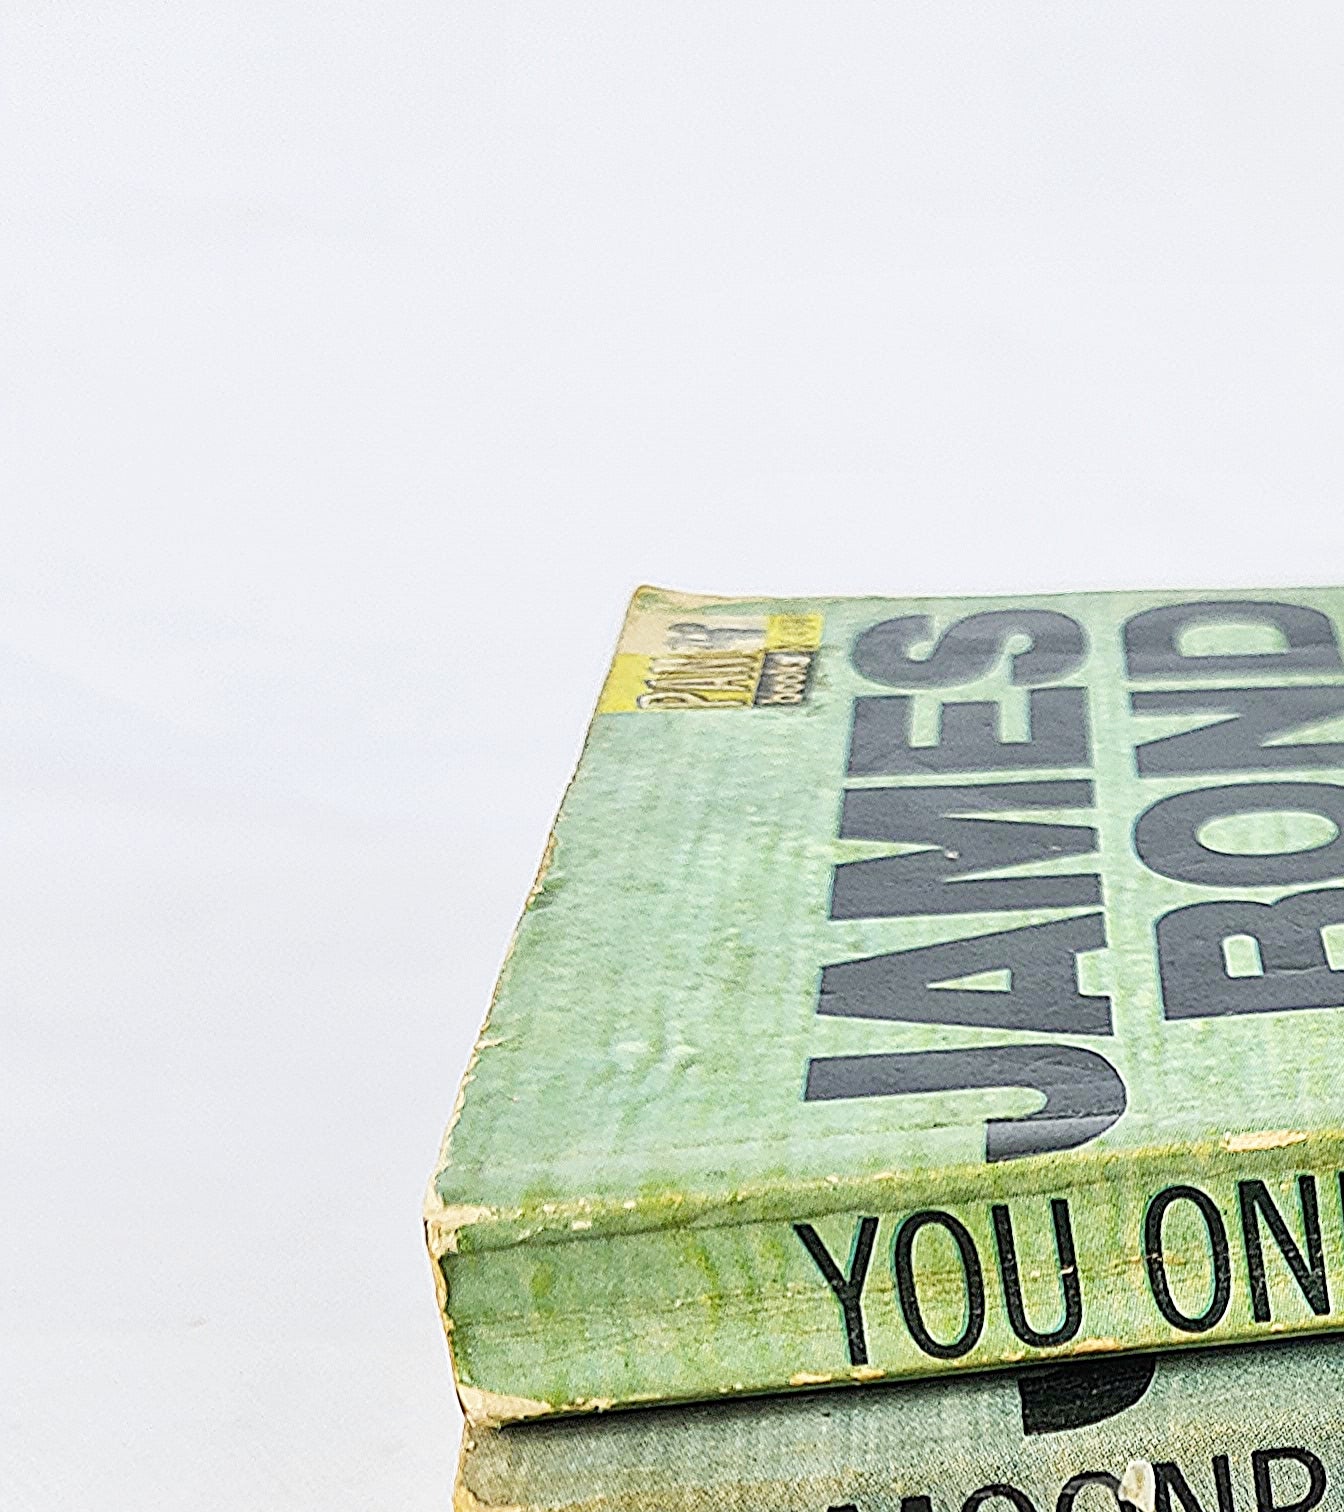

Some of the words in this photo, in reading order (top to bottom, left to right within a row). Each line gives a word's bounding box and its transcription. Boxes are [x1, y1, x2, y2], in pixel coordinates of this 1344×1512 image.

[637, 652, 758, 709] PAN
[804, 607, 1128, 1163] JAMES
[792, 1197, 1083, 1367] YOU
